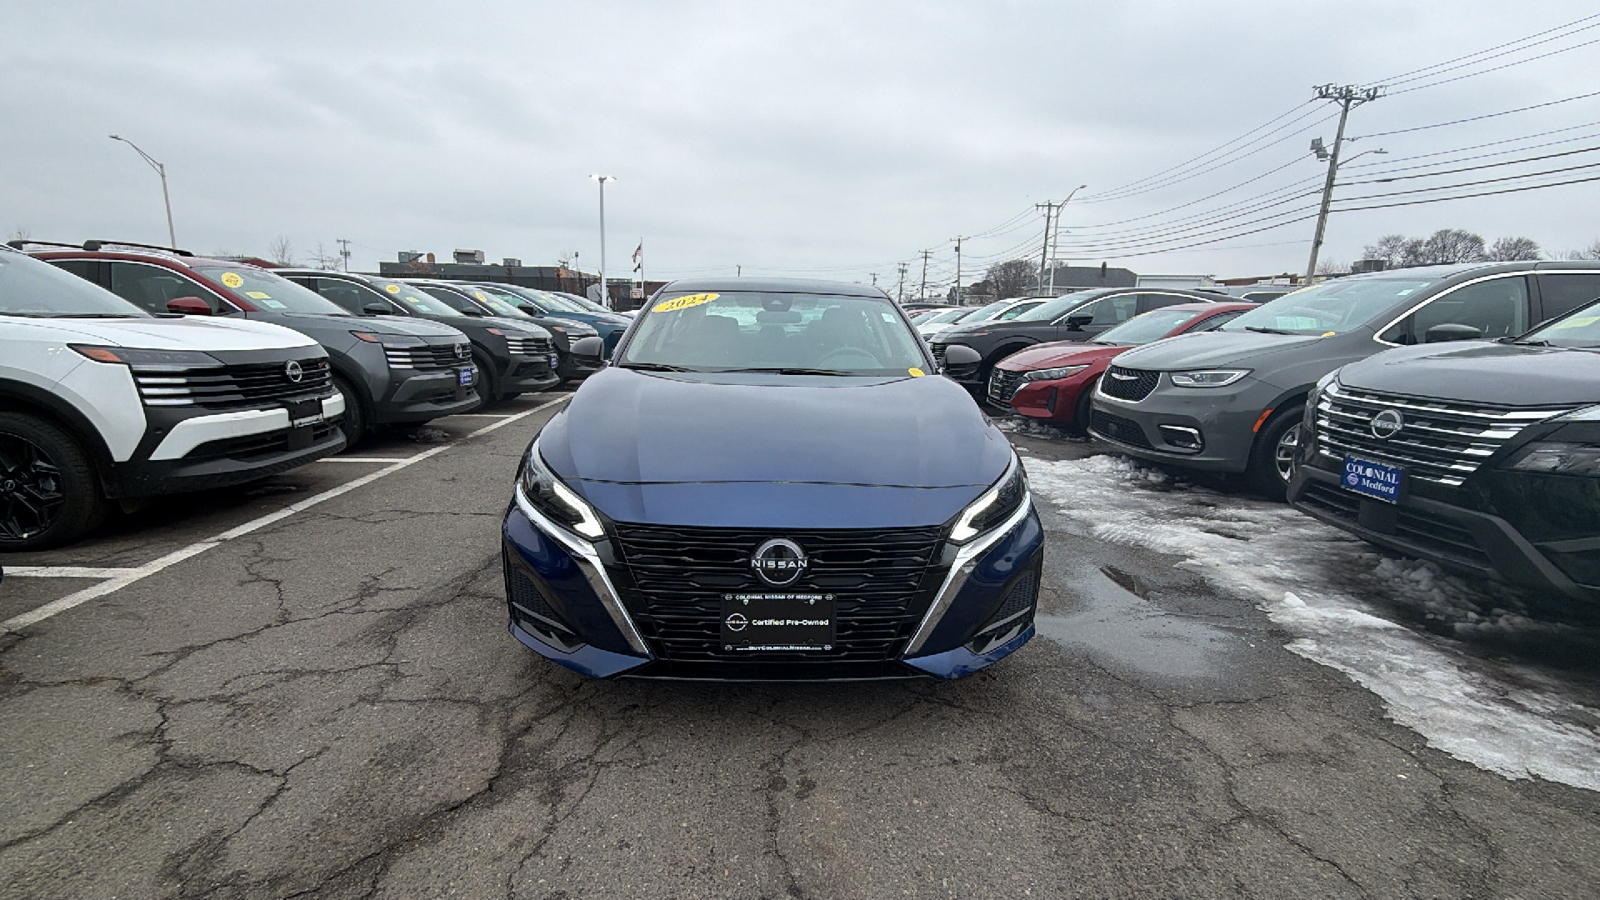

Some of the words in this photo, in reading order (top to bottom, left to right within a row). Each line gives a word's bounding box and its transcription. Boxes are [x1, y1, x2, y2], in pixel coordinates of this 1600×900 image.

[665, 294, 709, 311] 2024
[1346, 462, 1399, 485] COLONIAL
[1361, 477, 1396, 494] Medford
[751, 559, 808, 569] NISSAN
[751, 618, 785, 626] Certified
[786, 618, 830, 626] Pre-Owned
